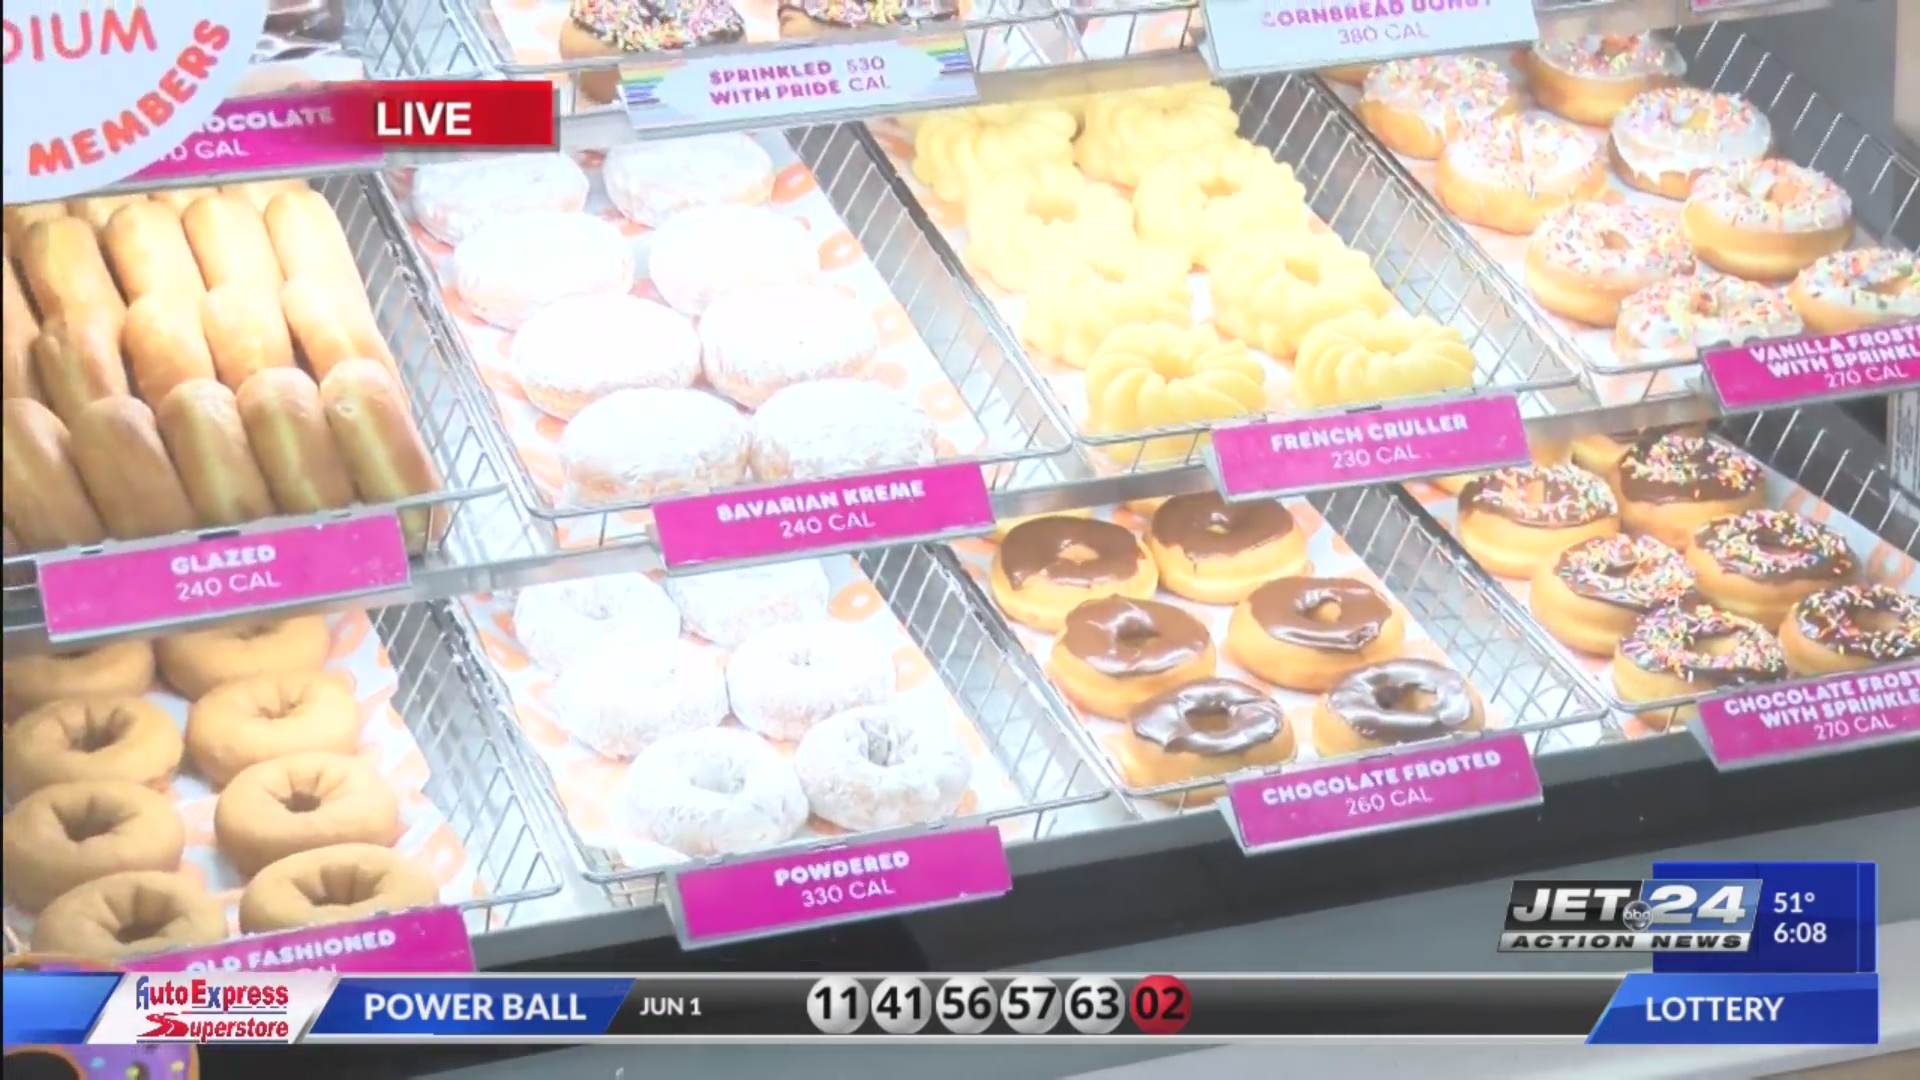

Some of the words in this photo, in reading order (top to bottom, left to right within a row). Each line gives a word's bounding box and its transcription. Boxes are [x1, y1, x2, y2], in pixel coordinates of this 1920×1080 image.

[1337, 27, 1377, 45] 380
[1385, 22, 1430, 39] CAL
[709, 61, 832, 85] SPRINKLED
[28, 19, 230, 176] MEMBERS
[710, 87, 771, 105] WITH
[776, 79, 841, 99] PRIDE
[849, 75, 890, 92] CAL
[198, 107, 334, 133] OCOLATE
[1750, 338, 1844, 364] VANILLA
[1767, 356, 1828, 378] WITH
[1824, 371, 1861, 388] 270
[1866, 364, 1908, 382] CAL
[1270, 426, 1363, 452] FRENCH
[1368, 413, 1468, 440] CRULLER
[1331, 449, 1370, 469] 230
[1376, 445, 1421, 463] CAL
[715, 491, 839, 522] BAVARIAN
[842, 480, 926, 507] KREME
[779, 517, 822, 538] 240
[828, 511, 875, 533] CAL
[170, 545, 277, 576] GLAZED
[175, 577, 222, 602] 240
[228, 570, 281, 591] CAL
[1724, 680, 1855, 716] CHOCOLATE
[1759, 706, 1818, 729] WITH
[1813, 722, 1850, 741] 270
[1853, 713, 1896, 733] CAL
[1261, 766, 1400, 806] CHOCOLATE
[1402, 750, 1501, 782] FROSTED
[1346, 795, 1385, 816] 260
[1389, 787, 1433, 806] CAL
[774, 850, 910, 887] POWDERED
[801, 885, 844, 908] 330
[848, 877, 896, 900] CAL
[248, 929, 396, 968] FASHIONED
